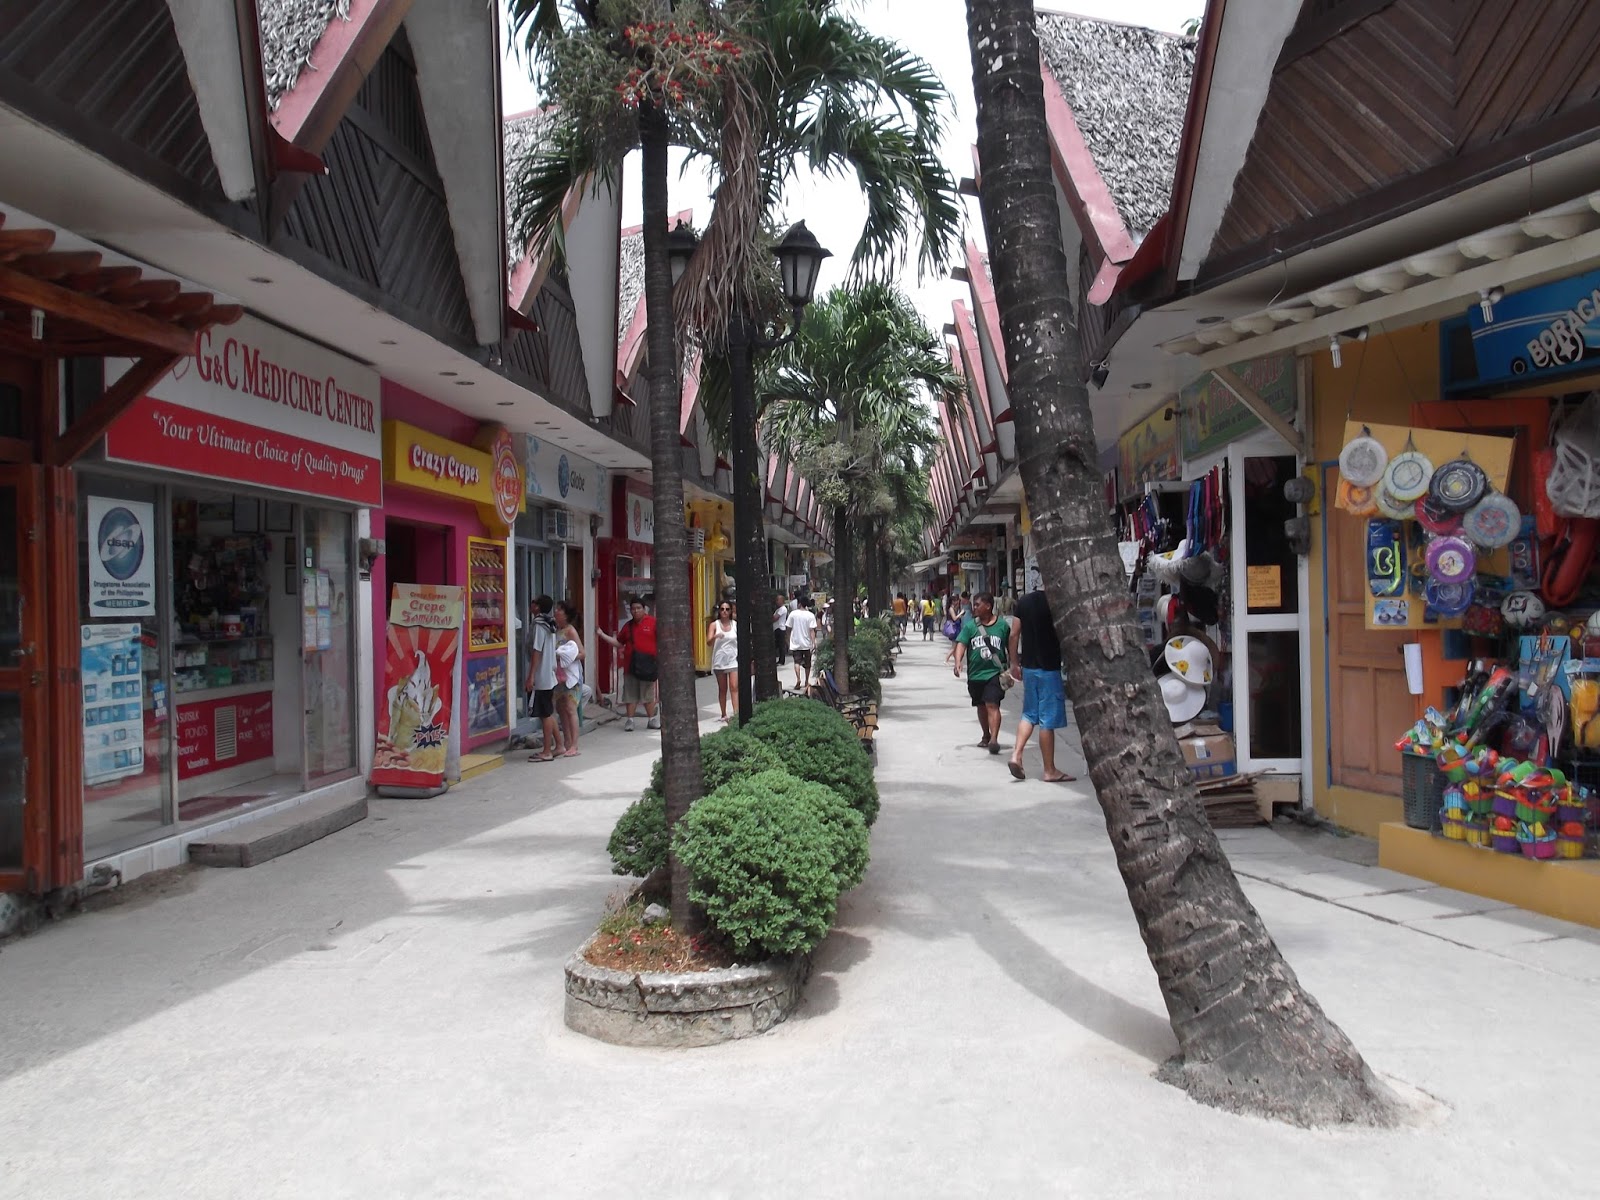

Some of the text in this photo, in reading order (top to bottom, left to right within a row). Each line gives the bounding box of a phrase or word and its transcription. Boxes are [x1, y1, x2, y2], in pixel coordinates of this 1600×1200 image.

[195, 330, 238, 391] G&C
[196, 424, 252, 455] Ultimate
[254, 439, 289, 462] Choice
[291, 448, 303, 471] of
[304, 452, 339, 480] Quality
[412, 444, 479, 485] Crazy Crepes
[570, 470, 585, 492] Globe
[100, 589, 144, 598] of the Philippines
[105, 599, 139, 608] MEMBER
[409, 599, 446, 614] Crepe
